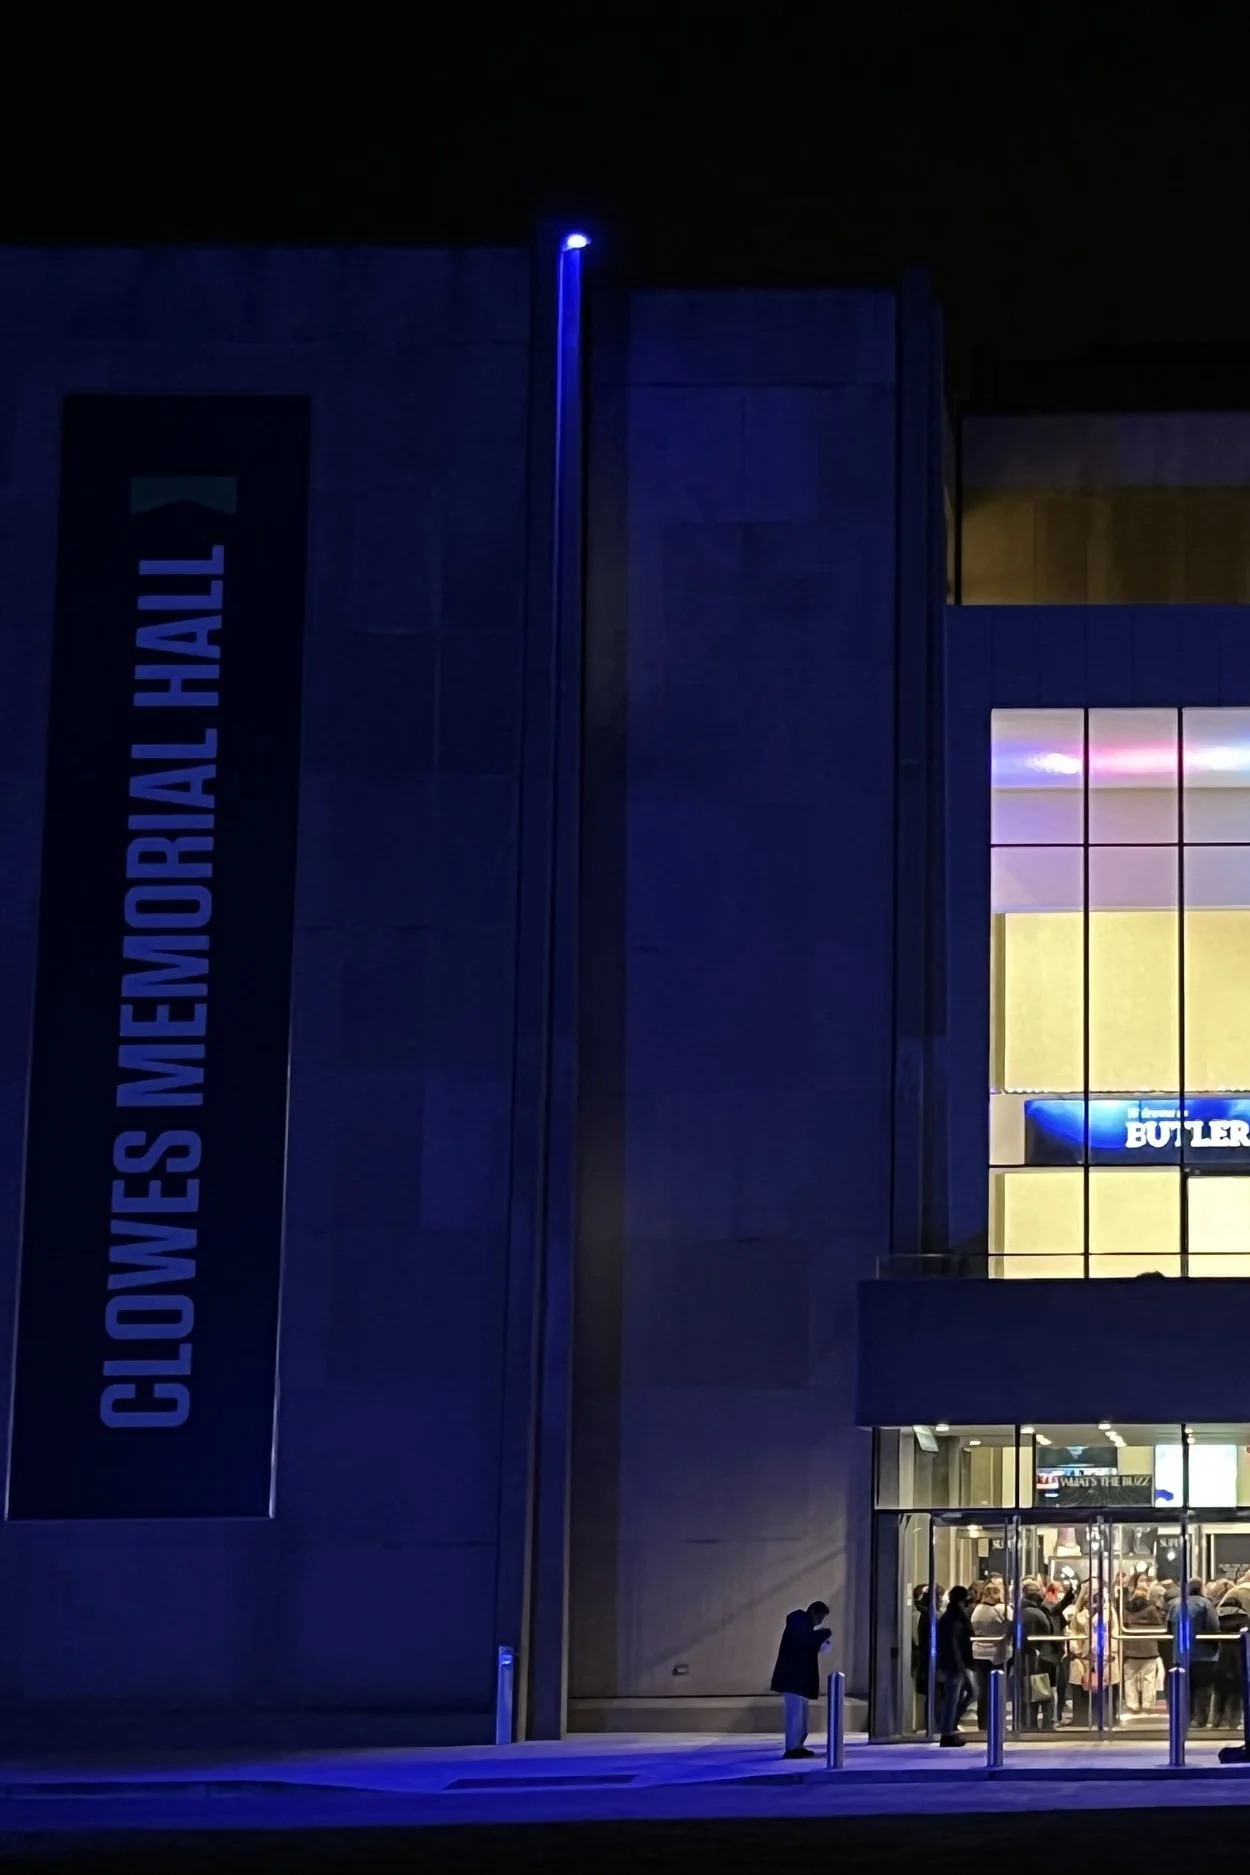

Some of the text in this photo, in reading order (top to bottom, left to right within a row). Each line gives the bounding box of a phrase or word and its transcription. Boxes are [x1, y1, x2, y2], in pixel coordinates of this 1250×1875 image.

[99, 544, 225, 1429] CLOWES MEMORIAL HALL
